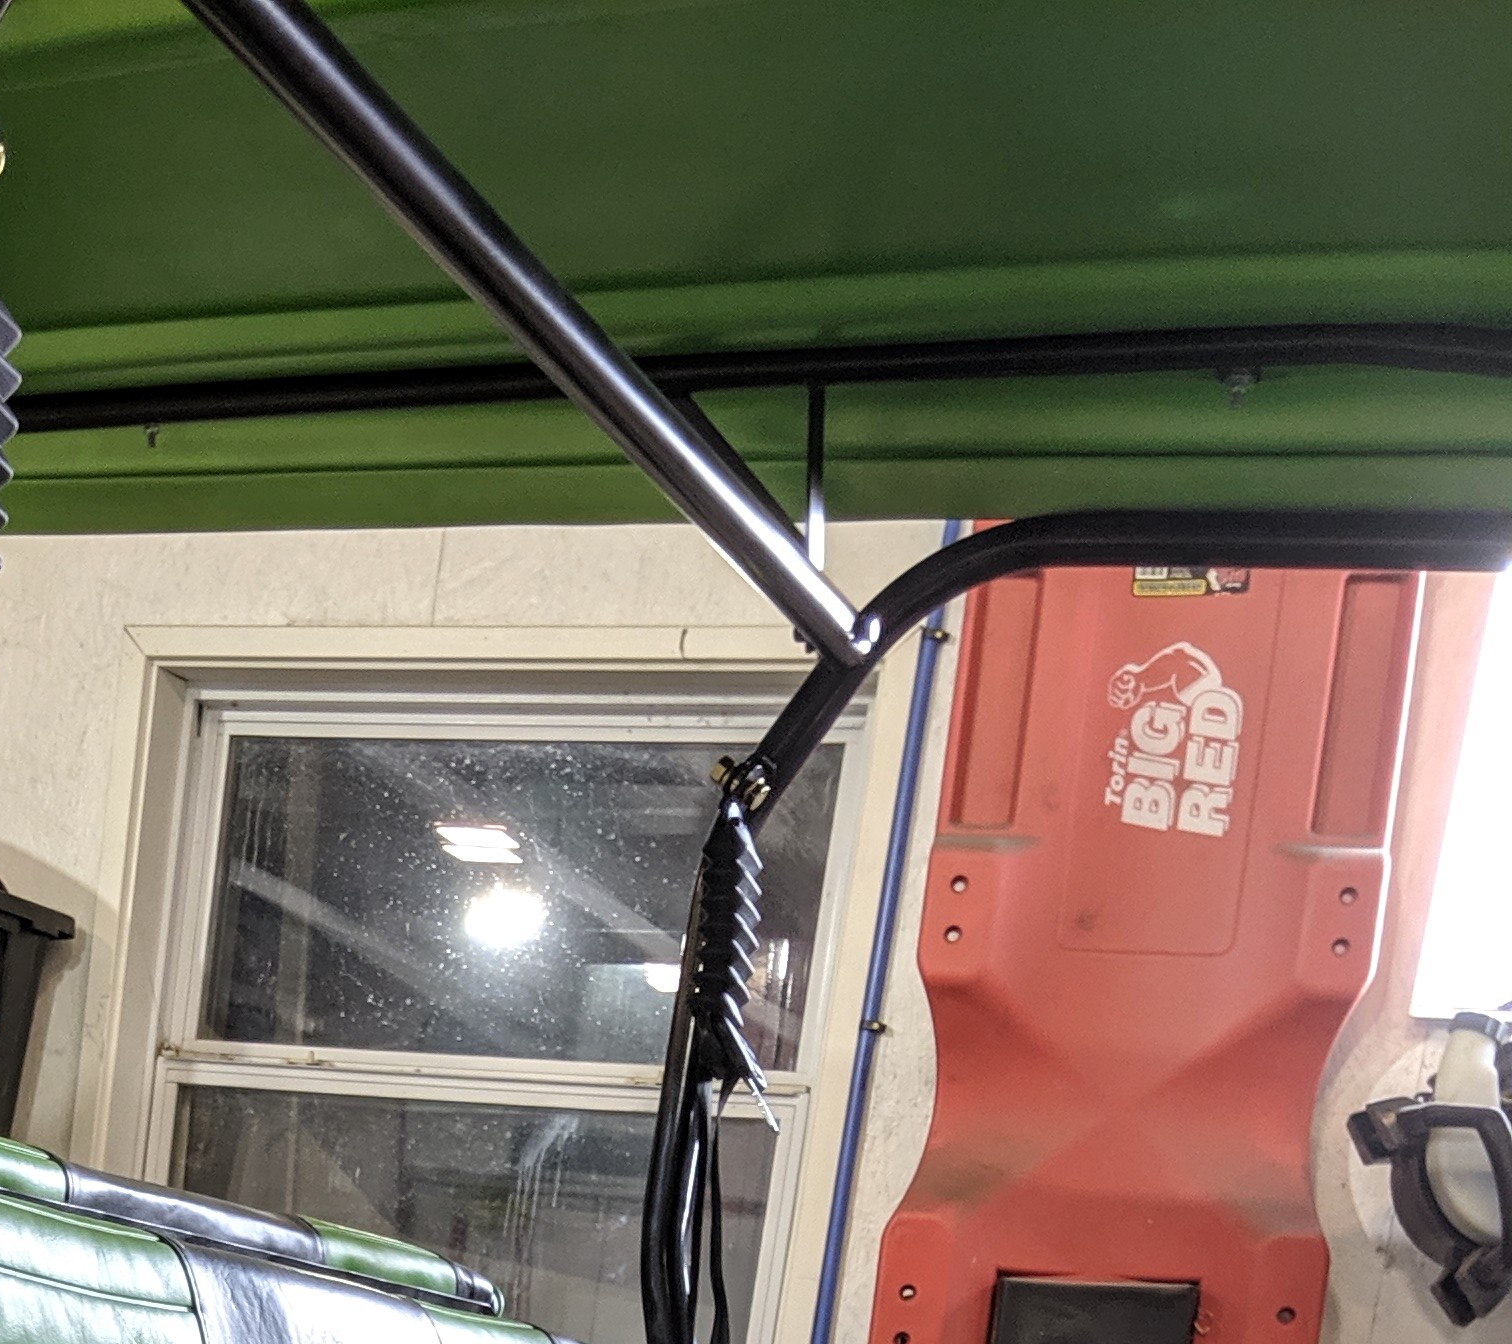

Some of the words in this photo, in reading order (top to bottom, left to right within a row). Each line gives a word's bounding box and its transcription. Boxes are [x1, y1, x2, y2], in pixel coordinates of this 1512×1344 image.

[1104, 735, 1129, 806] Torin
[1121, 701, 1188, 832] BIG
[1176, 685, 1244, 838] RED
